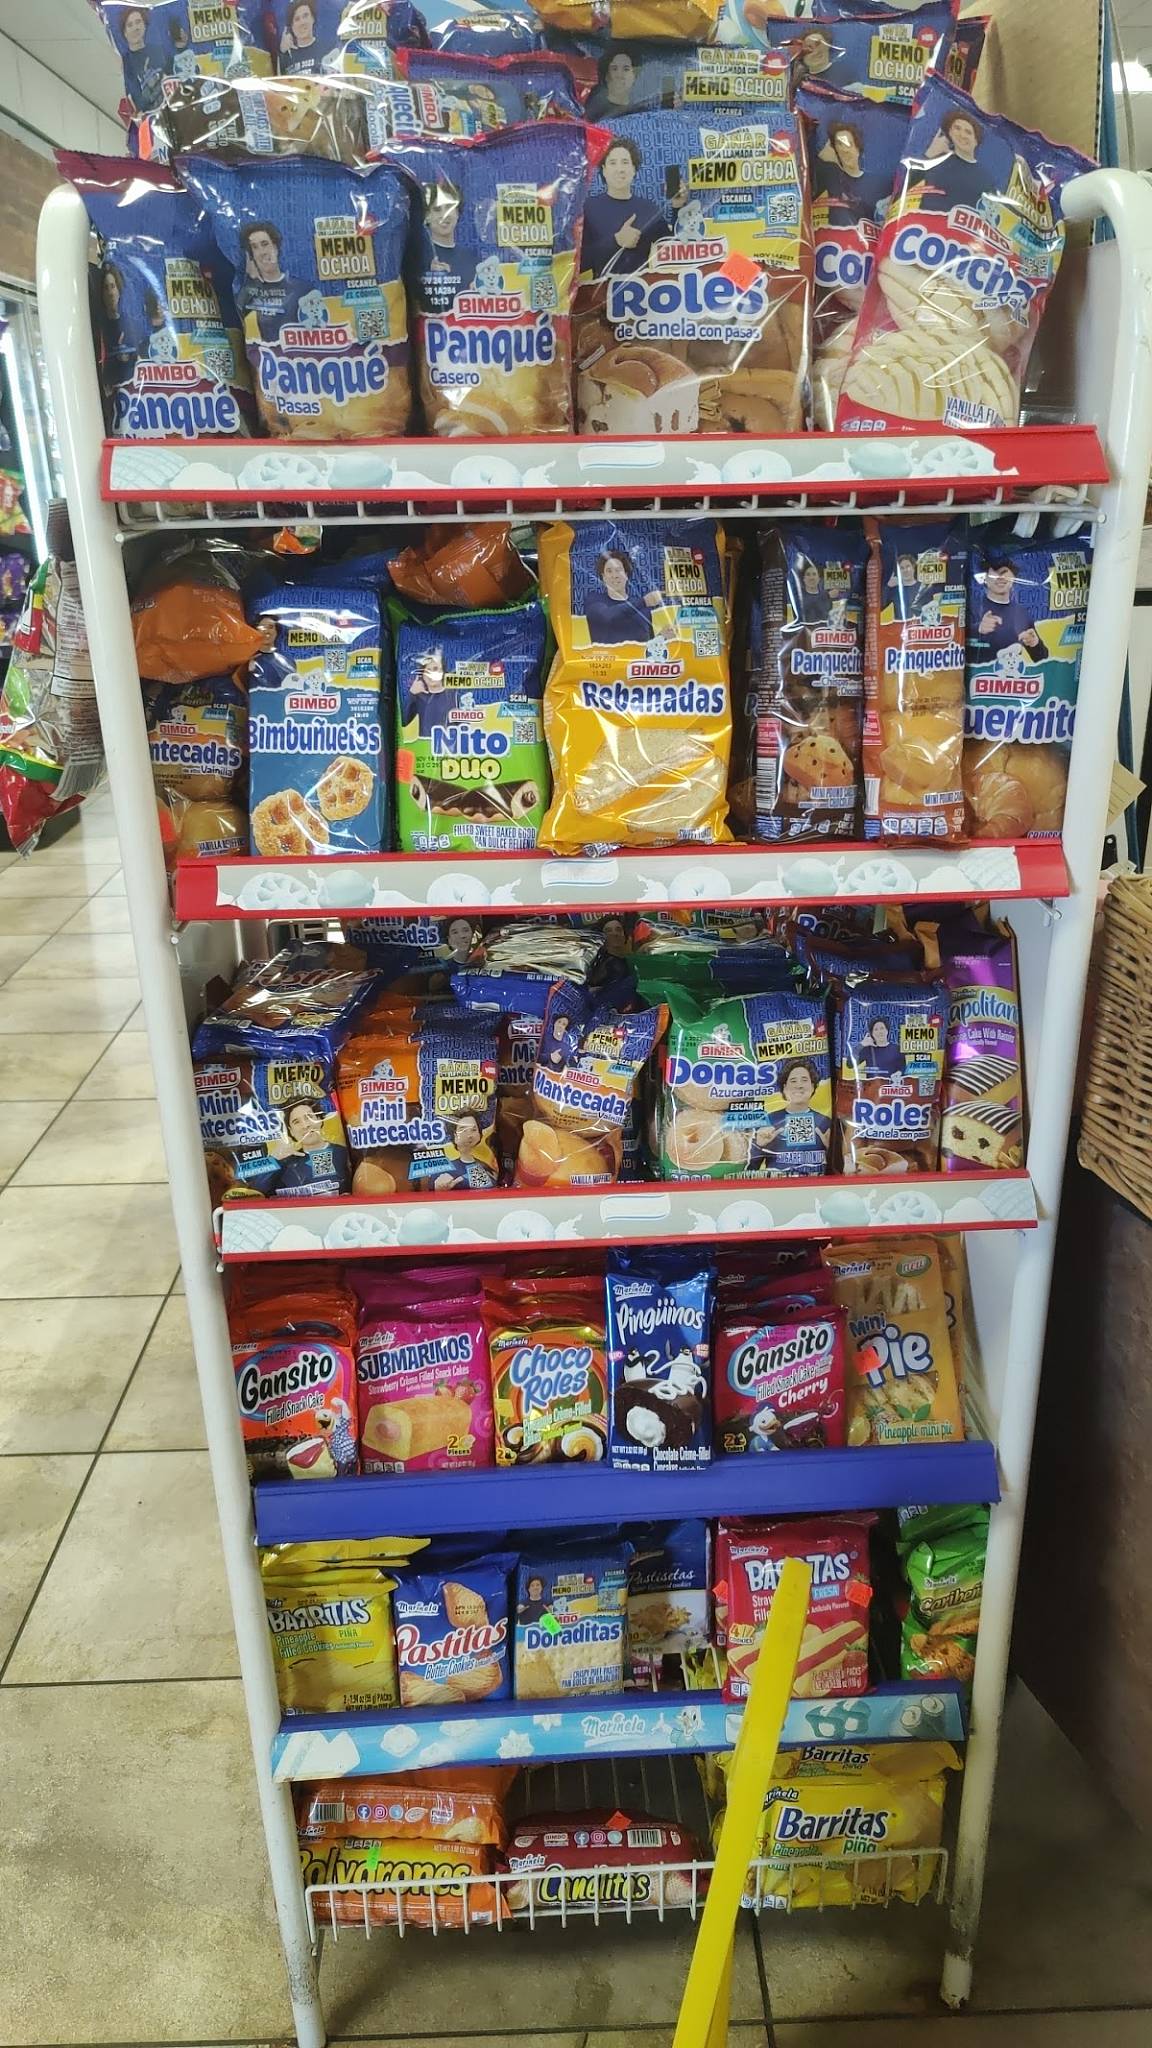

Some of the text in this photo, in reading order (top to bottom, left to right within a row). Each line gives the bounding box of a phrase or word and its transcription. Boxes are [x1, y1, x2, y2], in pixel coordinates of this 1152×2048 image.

[194, 7, 231, 24] MEMO
[878, 42, 924, 63] MEMO
[874, 59, 924, 81] OCHOA
[686, 76, 783, 97] MEMO OCHOA
[704, 132, 767, 150] GANAR
[691, 159, 797, 183] MEMO OCHOA
[722, 194, 753, 205] ESCANEA
[503, 206, 546, 224] MEMO
[501, 224, 550, 242] OCHOA
[954, 210, 1010, 252] BIMBO
[321, 236, 366, 257] MEMO
[656, 242, 725, 262] BIMBO
[320, 255, 371, 277] OCHOA
[457, 297, 522, 314] BIMBO
[611, 275, 765, 321] Roles
[171, 298, 217, 316] OCHOA
[283, 328, 348, 345] BIMBO
[617, 322, 634, 340] de
[636, 319, 696, 338] Canela
[698, 324, 724, 338] con
[427, 315, 553, 374] Panqué
[137, 364, 197, 380] BIMBO
[261, 346, 387, 404] Panqué
[430, 369, 480, 386] Casero
[116, 384, 236, 437] Panqué
[278, 397, 321, 416] Pasas
[667, 579, 704, 593] OCHOA
[682, 597, 712, 606] ESCANEA
[290, 631, 319, 643] MEMO
[815, 634, 854, 644] BIMBO
[908, 629, 952, 645] BIMBO
[631, 664, 681, 676] BIMBO
[446, 676, 472, 687] MEMO
[975, 679, 1040, 695] BIMBO
[289, 697, 338, 710] BIMBO
[509, 694, 528, 703] SCAN
[583, 682, 723, 716] Rebanadas
[451, 711, 485, 720] BIMBO
[159, 724, 197, 735] BIMBO
[433, 726, 508, 756] Nito
[442, 758, 502, 780] DUO
[592, 1033, 618, 1047] MEMO
[905, 1028, 935, 1040] MEMO
[701, 1045, 743, 1056] BIMBO
[758, 1042, 793, 1058] MEMO
[903, 1040, 936, 1051] OCHOA
[915, 1054, 931, 1062] SCAN
[195, 1072, 237, 1088] BIMBO
[273, 1066, 321, 1084] MEMO
[566, 1072, 601, 1086] BIMBO
[669, 1059, 777, 1085] Donas
[360, 1081, 405, 1093] BIMBO
[442, 1078, 489, 1095] MEMO
[710, 1087, 774, 1098] Azucaradas
[881, 1086, 913, 1095] BIMBO
[199, 1089, 240, 1117] Mini
[363, 1098, 405, 1121] Mini
[730, 1103, 764, 1112] ESCANEA
[866, 1126, 899, 1139] Canela
[242, 1150, 263, 1161] SCAN
[414, 1151, 445, 1161] ESCANEA
[833, 1262, 872, 1276] Marinela
[614, 1282, 652, 1296] Marinela
[616, 1299, 705, 1346] Pingüinos
[849, 1312, 886, 1337] Mini
[358, 1334, 472, 1382] SUBMARINOS
[511, 1345, 593, 1384] Choco
[738, 1328, 828, 1386] Gansito
[241, 1353, 334, 1410] Gansito
[369, 1380, 399, 1395] Strawberry
[418, 1371, 435, 1385] Filled
[435, 1368, 453, 1380] Snack
[452, 1365, 470, 1378] Cakes
[756, 1380, 775, 1401] Filled
[797, 1366, 815, 1383] Cake
[522, 1370, 588, 1415] Roles
[778, 1377, 829, 1409] Cherry
[266, 1392, 324, 1426] Filled Snack Cake
[879, 1422, 953, 1440] Pineapple mini pie
[449, 1435, 458, 1449] 2
[448, 1449, 470, 1457] Pieces
[653, 1446, 679, 1461] Chocolate
[398, 1601, 439, 1614] Marinela
[270, 1599, 371, 1634] BARRITAS
[276, 1632, 317, 1647] Pineapple
[527, 1619, 620, 1650] Doraditas
[730, 1636, 754, 1644] COOKIES
[731, 1626, 740, 1638] 4
[397, 1617, 508, 1669] Pastitas
[280, 1646, 302, 1659] Filled
[425, 1663, 449, 1681] Butter
[448, 1656, 476, 1677] Cookies
[581, 1712, 645, 1737] Marinela
[801, 1745, 871, 1764] Barritas
[777, 1806, 889, 1840] Barritas
[843, 1837, 878, 1854] piña
[510, 1854, 546, 1868] Marinela
[540, 1865, 652, 1903] Canelitas
